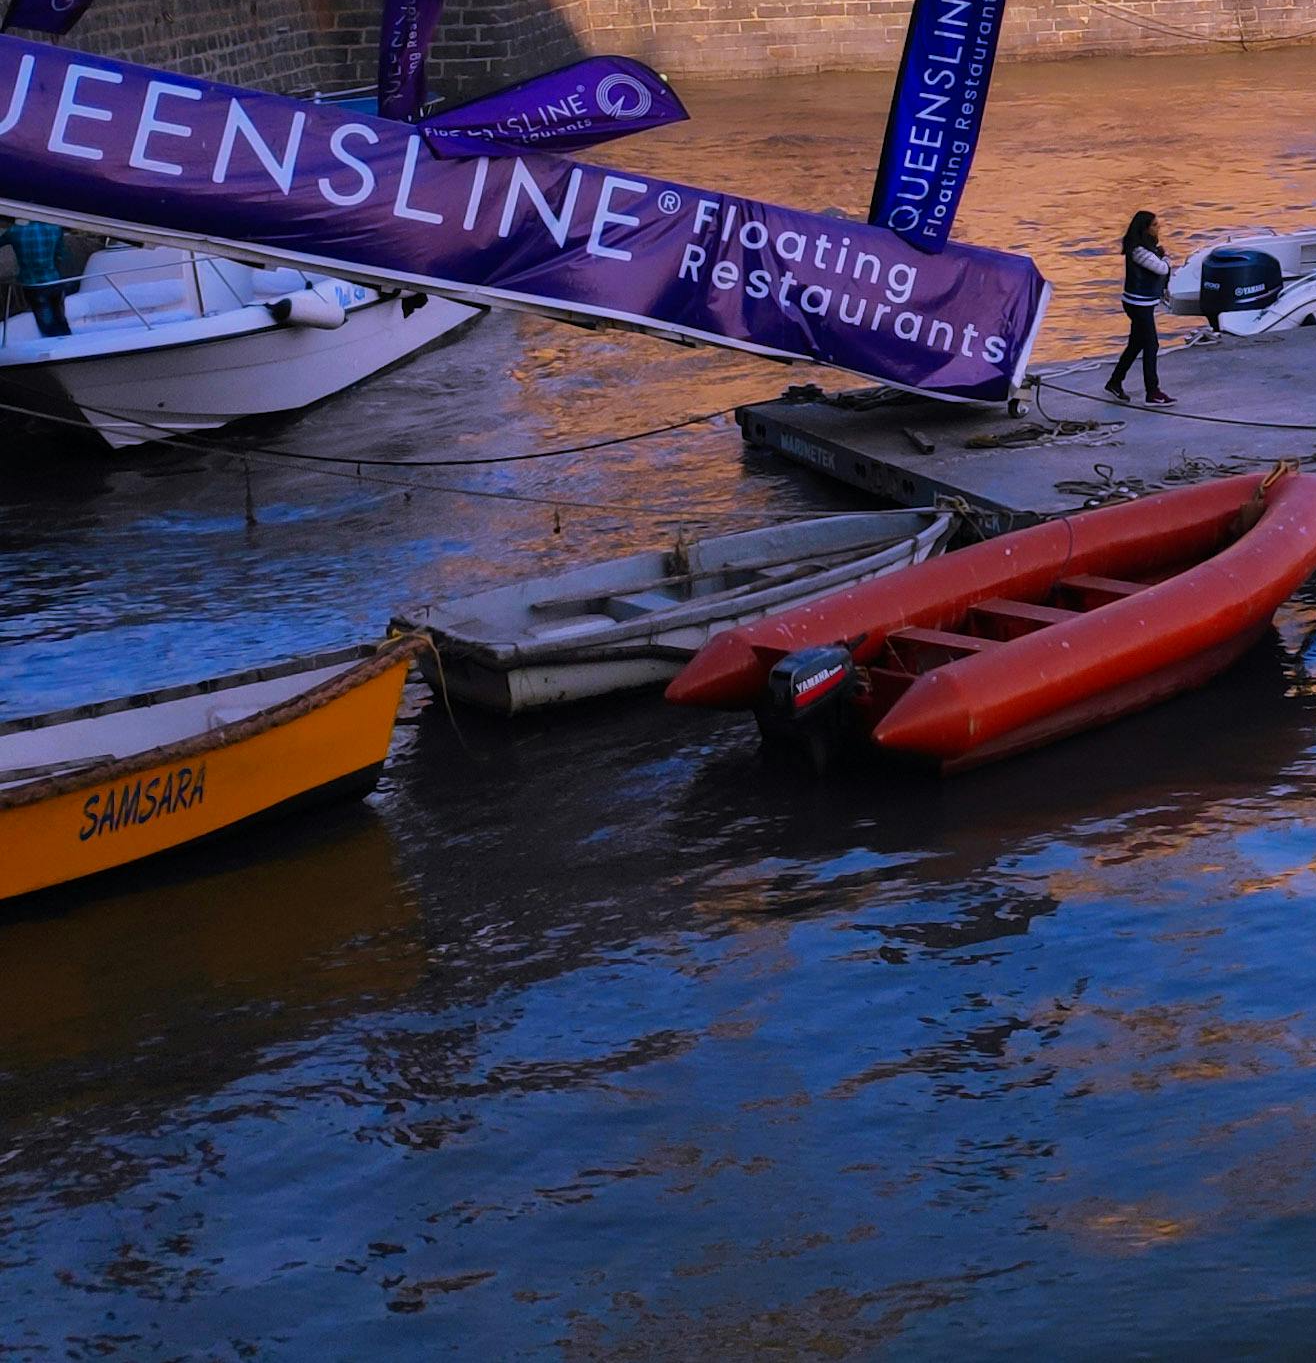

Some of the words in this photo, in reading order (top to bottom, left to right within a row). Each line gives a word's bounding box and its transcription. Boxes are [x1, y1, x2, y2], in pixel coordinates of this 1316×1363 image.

[922, 140, 970, 237] Floating
[692, 199, 918, 304] Floating
[678, 243, 1007, 364] Restaurants
[79, 760, 206, 842] SAMSARA
